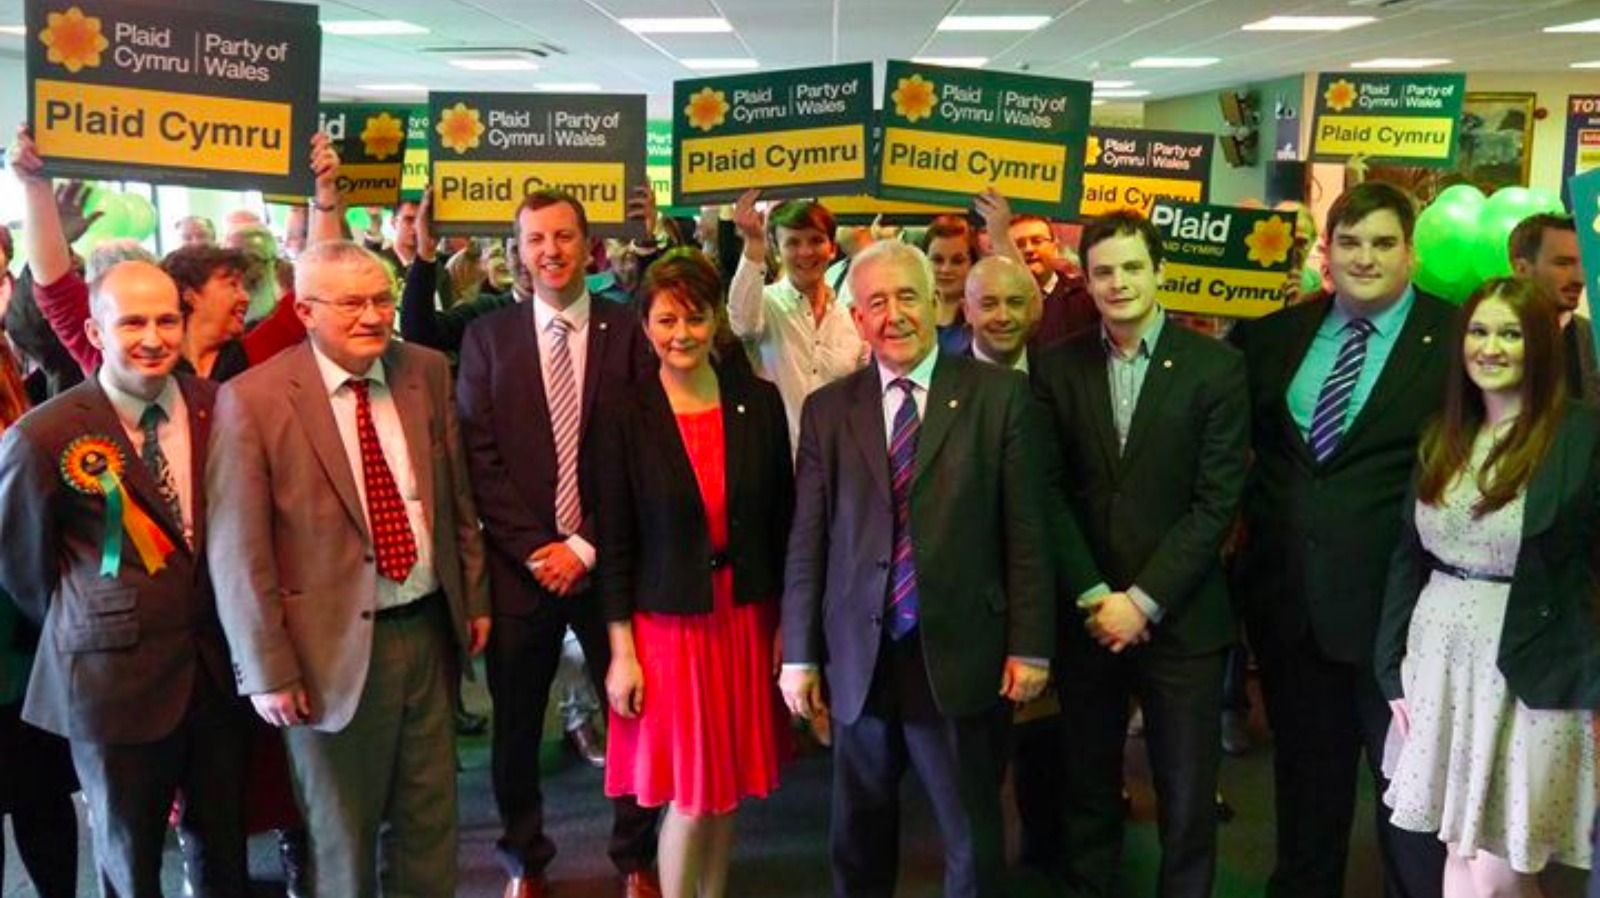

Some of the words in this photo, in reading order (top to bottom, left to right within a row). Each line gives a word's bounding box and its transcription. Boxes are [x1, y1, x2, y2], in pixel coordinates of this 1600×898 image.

[114, 22, 170, 48] Plaid
[205, 33, 262, 62] Party
[266, 42, 288, 61] of
[114, 45, 189, 73] Cymru
[204, 56, 270, 82] Wales
[733, 87, 772, 104] Plaid
[797, 83, 840, 99] Party
[841, 79, 858, 95] of
[942, 84, 981, 104] Plaid
[1361, 83, 1389, 96] Plaid
[1406, 84, 1440, 98] Party
[1441, 84, 1455, 96] of
[796, 99, 845, 115] Wales
[1005, 91, 1048, 113] Party
[1050, 96, 1067, 112] of
[1359, 96, 1398, 109] Cymru
[1406, 97, 1443, 108] Wales
[489, 111, 529, 128] Plaid
[555, 111, 600, 132] Party
[602, 112, 620, 128] of
[733, 104, 786, 123] Cymru
[940, 102, 994, 123] Cymru
[1004, 108, 1052, 128] Wales
[46, 100, 144, 138] Plaid
[159, 110, 281, 150] Cymru
[488, 130, 545, 149] Cymru
[555, 131, 606, 147] Wales
[1104, 138, 1136, 153] Plaid
[1322, 125, 1371, 141] Plaid
[1377, 127, 1445, 147] Cymru
[688, 147, 755, 174] Plaid
[765, 143, 857, 172] Cymru
[1103, 151, 1145, 168] Cymru
[1153, 142, 1187, 159] Party
[1188, 144, 1203, 157] of
[890, 143, 958, 171] Plaid
[968, 151, 1057, 182] Cymru
[1152, 156, 1190, 170] Wales
[335, 176, 396, 192] Cymru
[442, 176, 511, 201] Plaid
[523, 178, 617, 202] Cmru
[1086, 185, 1116, 202] aid
[1151, 204, 1232, 243] Plaid
[1158, 276, 1202, 295] aid
[1208, 279, 1283, 302] Cymru
